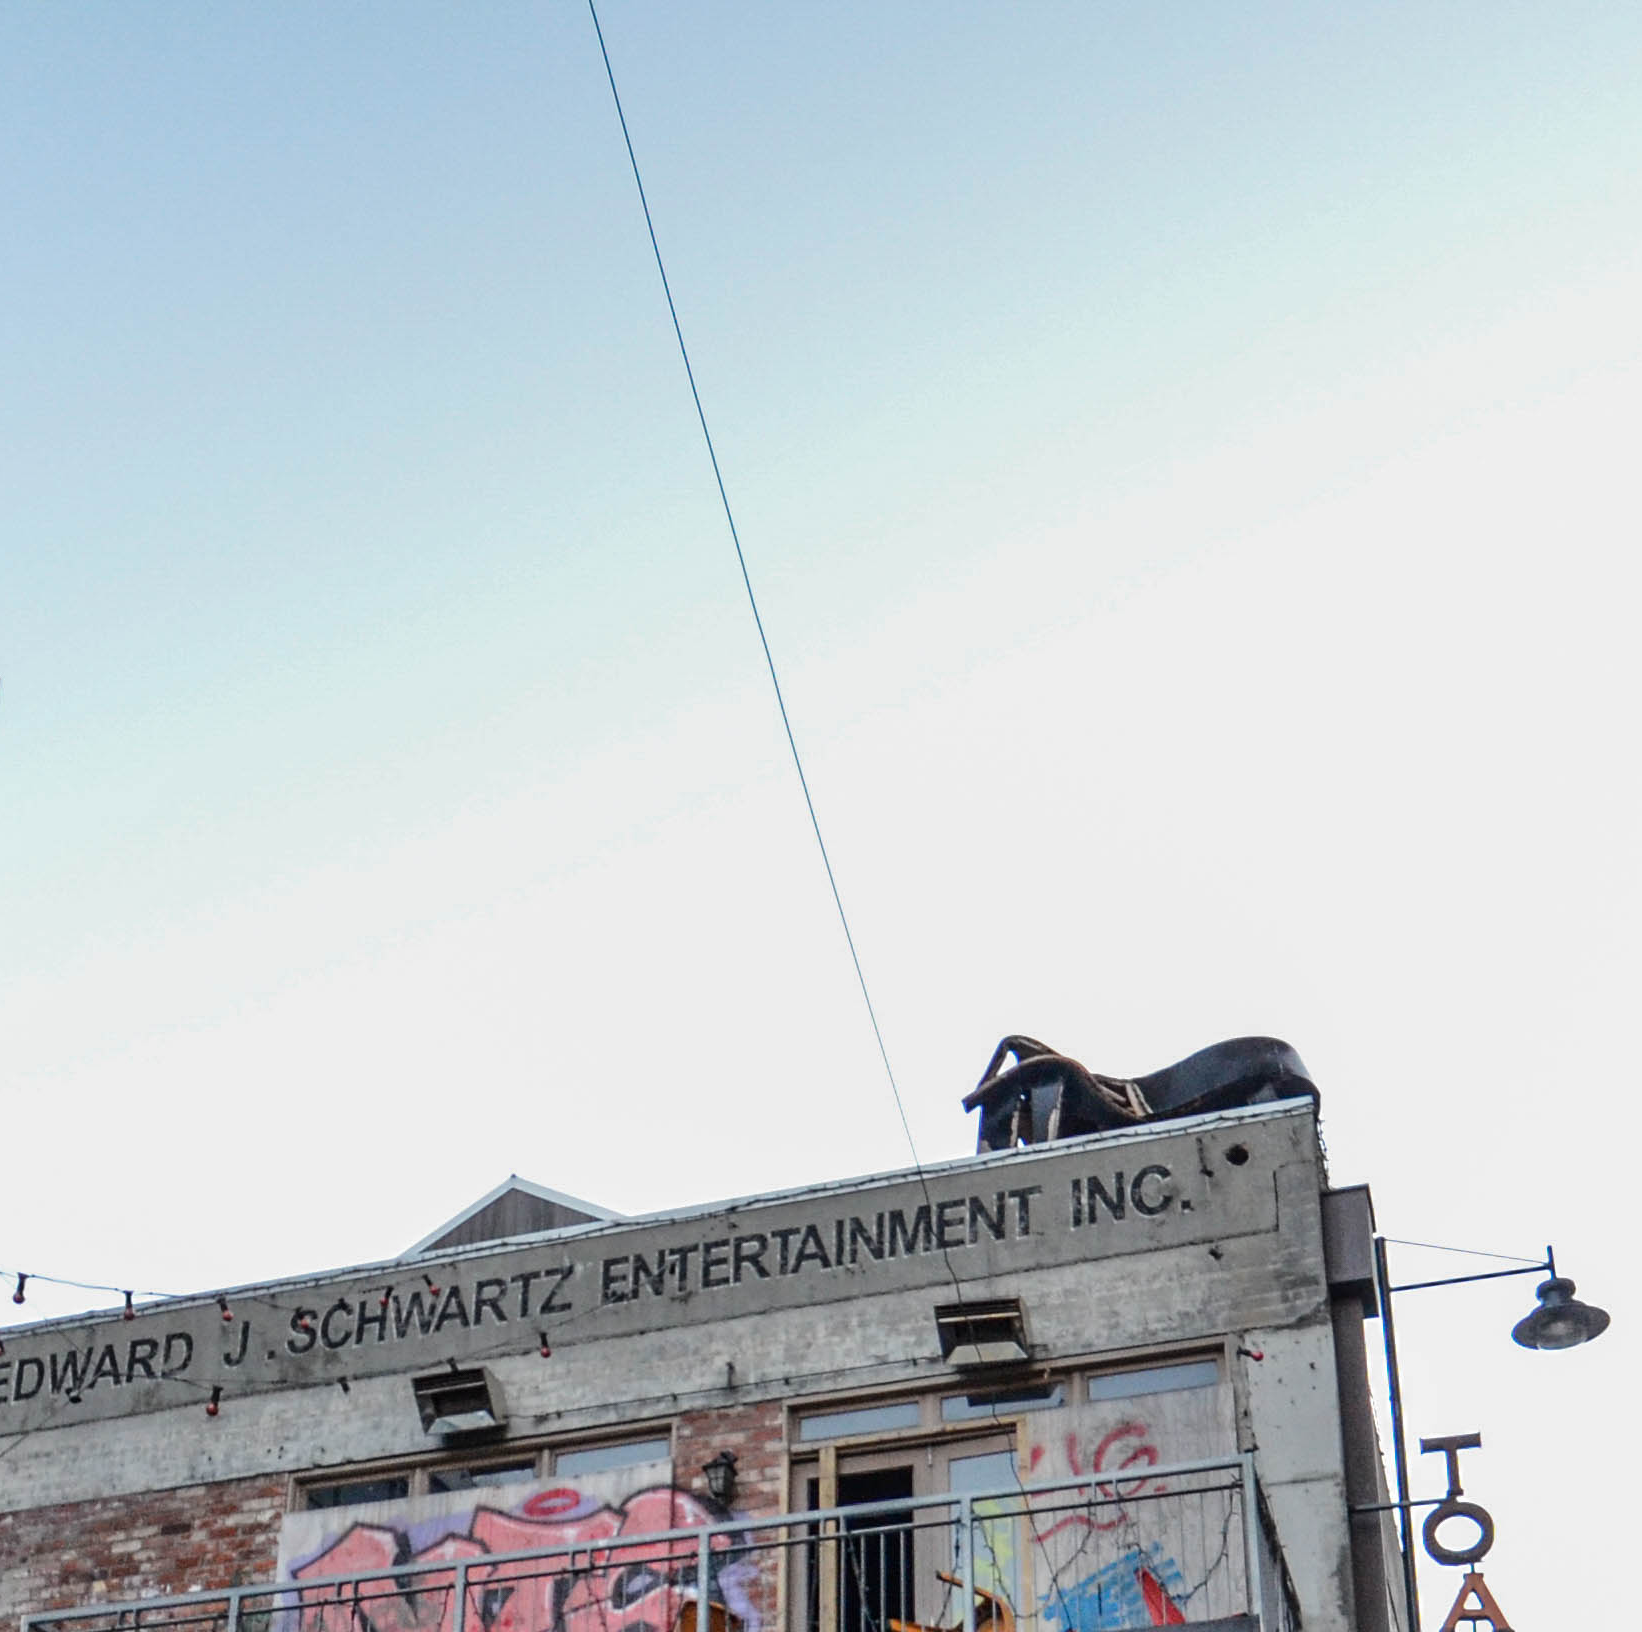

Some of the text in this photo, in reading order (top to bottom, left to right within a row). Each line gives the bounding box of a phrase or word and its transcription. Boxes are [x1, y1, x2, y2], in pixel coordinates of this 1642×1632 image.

[287, 1265, 576, 1355] SCHWARTZ
[601, 1184, 1044, 1304] ENTERTAINMENT
[1069, 1163, 1195, 1231] INC.
